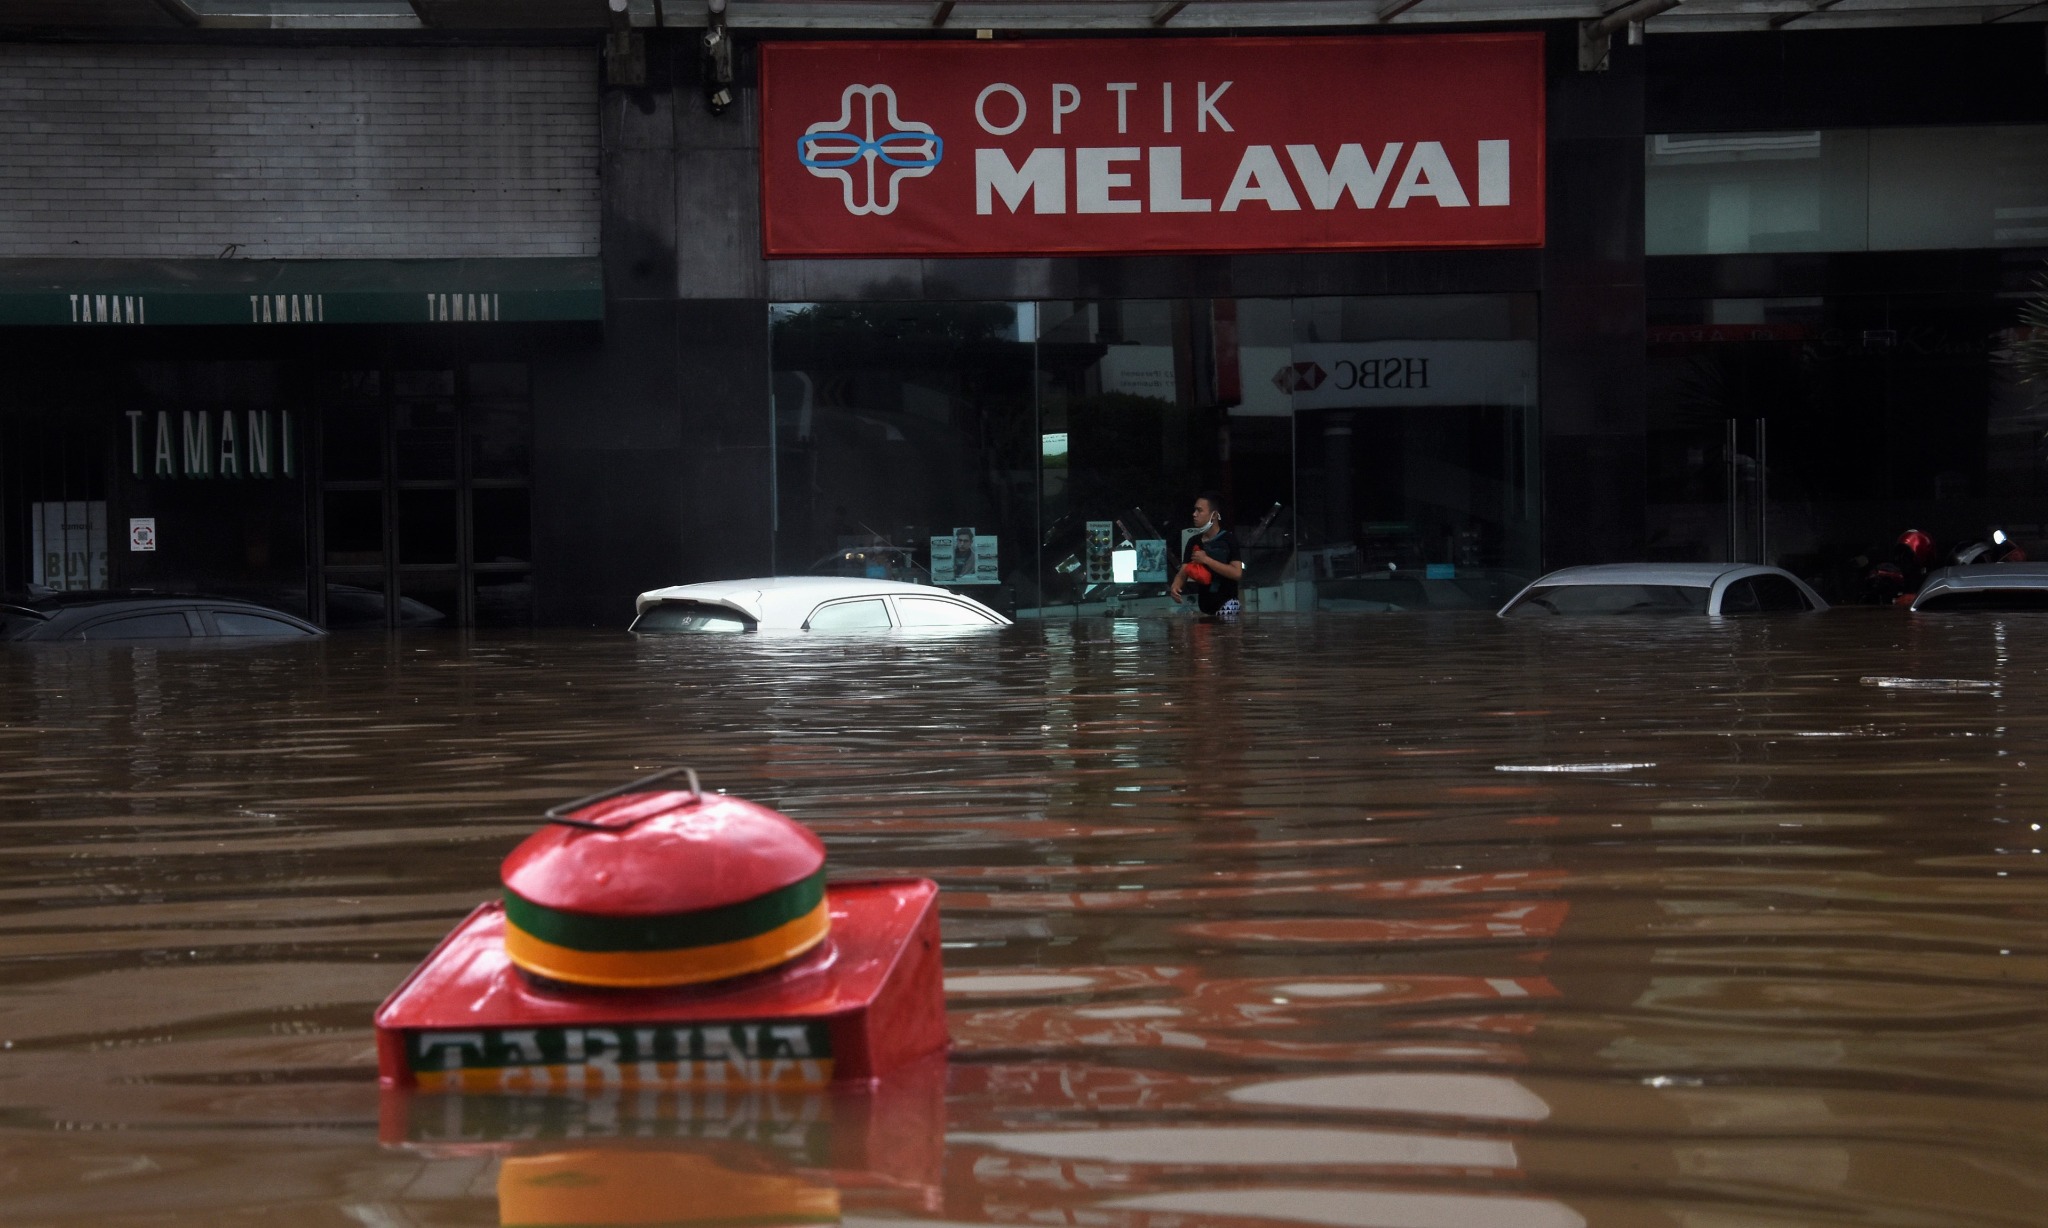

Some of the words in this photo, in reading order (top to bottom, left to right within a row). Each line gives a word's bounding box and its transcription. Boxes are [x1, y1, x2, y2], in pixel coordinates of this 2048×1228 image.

[975, 81, 1235, 136] OPTIK
[976, 139, 1510, 215] MELAWAI
[70, 294, 145, 325] TAMANI
[250, 294, 324, 323] TAMANI
[427, 292, 500, 322] TAMANI
[125, 409, 294, 479] TAMANI
